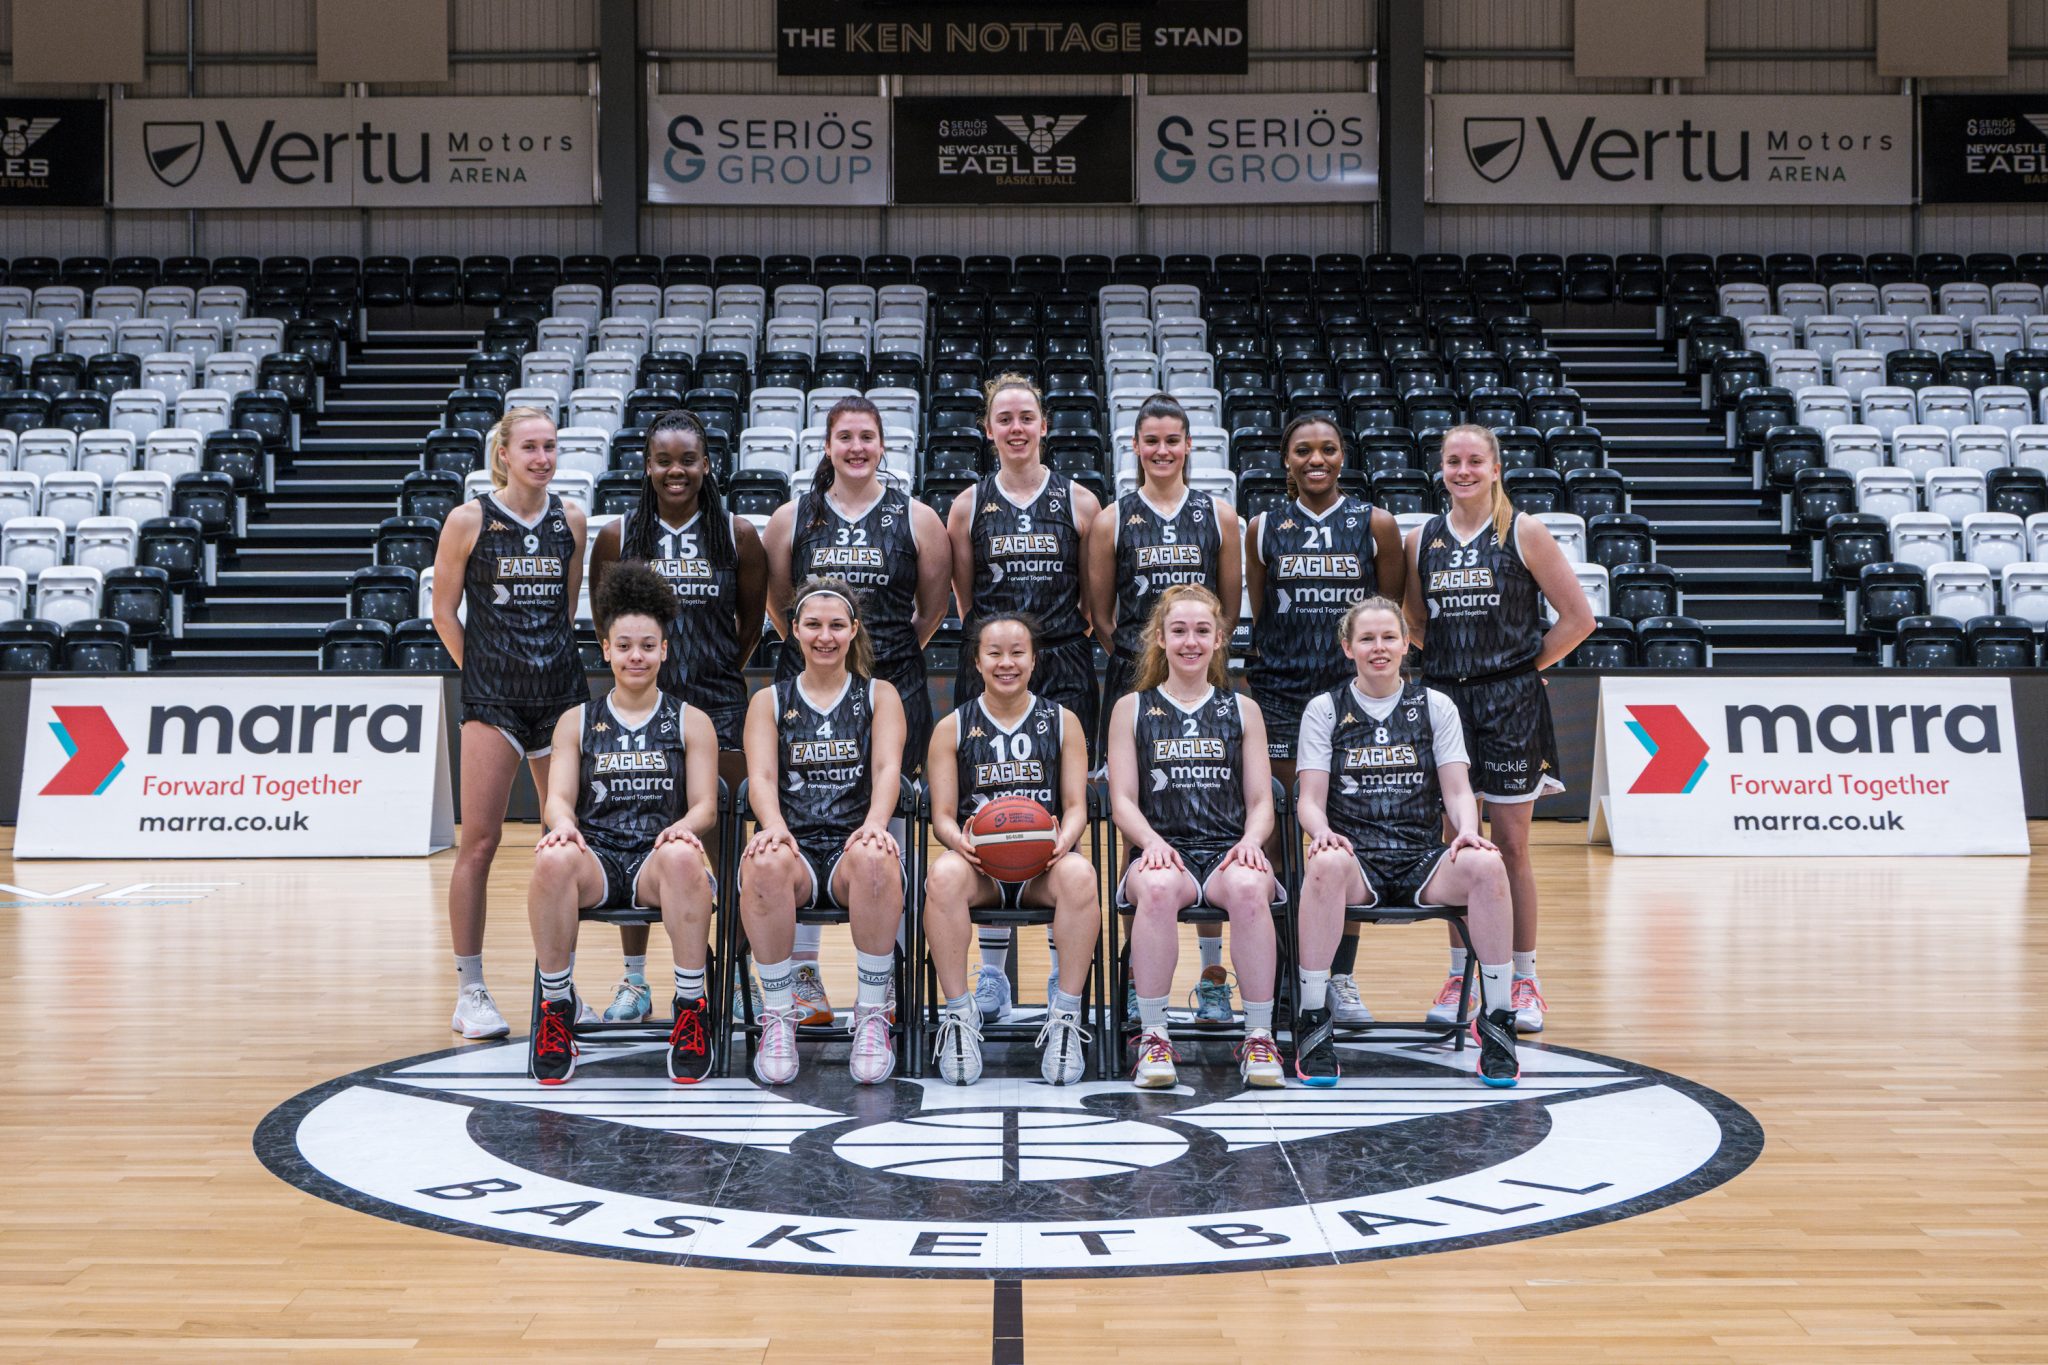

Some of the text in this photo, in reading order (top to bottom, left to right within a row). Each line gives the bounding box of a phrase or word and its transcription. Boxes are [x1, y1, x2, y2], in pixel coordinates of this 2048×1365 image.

[783, 22, 1242, 53] THE KEN NOTTAGE STAND
[718, 112, 873, 150] SERIÖS
[1206, 109, 1363, 148] SERIÖS
[1979, 128, 2016, 136] GROUP
[449, 131, 573, 152] Motors
[939, 145, 1018, 155] NEWCASTLE
[1536, 116, 1750, 182] Vertu
[1767, 130, 1893, 151] Motors
[1967, 143, 2046, 154] NEWCASTLE
[216, 120, 430, 184] Vertu
[0, 159, 49, 176] ES
[450, 166, 527, 183] ARENA
[718, 156, 872, 184] GROUP
[938, 156, 1077, 174] EAGLES
[1207, 154, 1362, 183] GROUP
[1768, 166, 1846, 182] ARENA
[996, 176, 1076, 185] BASKETBALL
[1018, 514, 1032, 533] 3
[523, 534, 539, 554] 9
[835, 528, 867, 546] 32
[1162, 525, 1177, 544] 5
[1302, 526, 1333, 549] 21
[658, 533, 698, 559] 15
[990, 534, 1060, 557] EAGLES
[498, 557, 562, 578] EAGLES
[812, 547, 883, 568] EAGLES
[1006, 560, 1064, 573] marra
[1136, 545, 1202, 569] EAGLES
[1277, 554, 1361, 580] EAGLES
[1448, 549, 1479, 568] 33
[1152, 571, 1206, 584] marra
[1428, 568, 1494, 592] EAGLES
[1295, 587, 1365, 603] marra
[1442, 593, 1500, 609] marra
[1295, 606, 1324, 614] Forward
[147, 704, 423, 754] marra
[816, 721, 833, 738] 4
[1182, 719, 1199, 737] 2
[1375, 727, 1389, 744] 8
[1725, 704, 2001, 754] marra
[617, 734, 646, 750] 11
[790, 739, 860, 765] EAGLES
[989, 733, 1032, 763] 10
[1154, 738, 1225, 762] EAGLES
[594, 751, 668, 774] EAGLES
[1345, 744, 1418, 769] EAGLES
[976, 760, 1044, 787] EAGLES
[1171, 766, 1231, 780] marra
[1361, 772, 1424, 785] marra
[143, 774, 362, 801] Forward Together
[611, 777, 674, 792] marra
[1730, 774, 1950, 801] Forward Together
[636, 794, 662, 802] Together
[139, 811, 309, 832] marra.co.uk
[1734, 811, 1905, 831] marra.co.uk
[415, 1176, 1615, 1257] BASKETBALL
